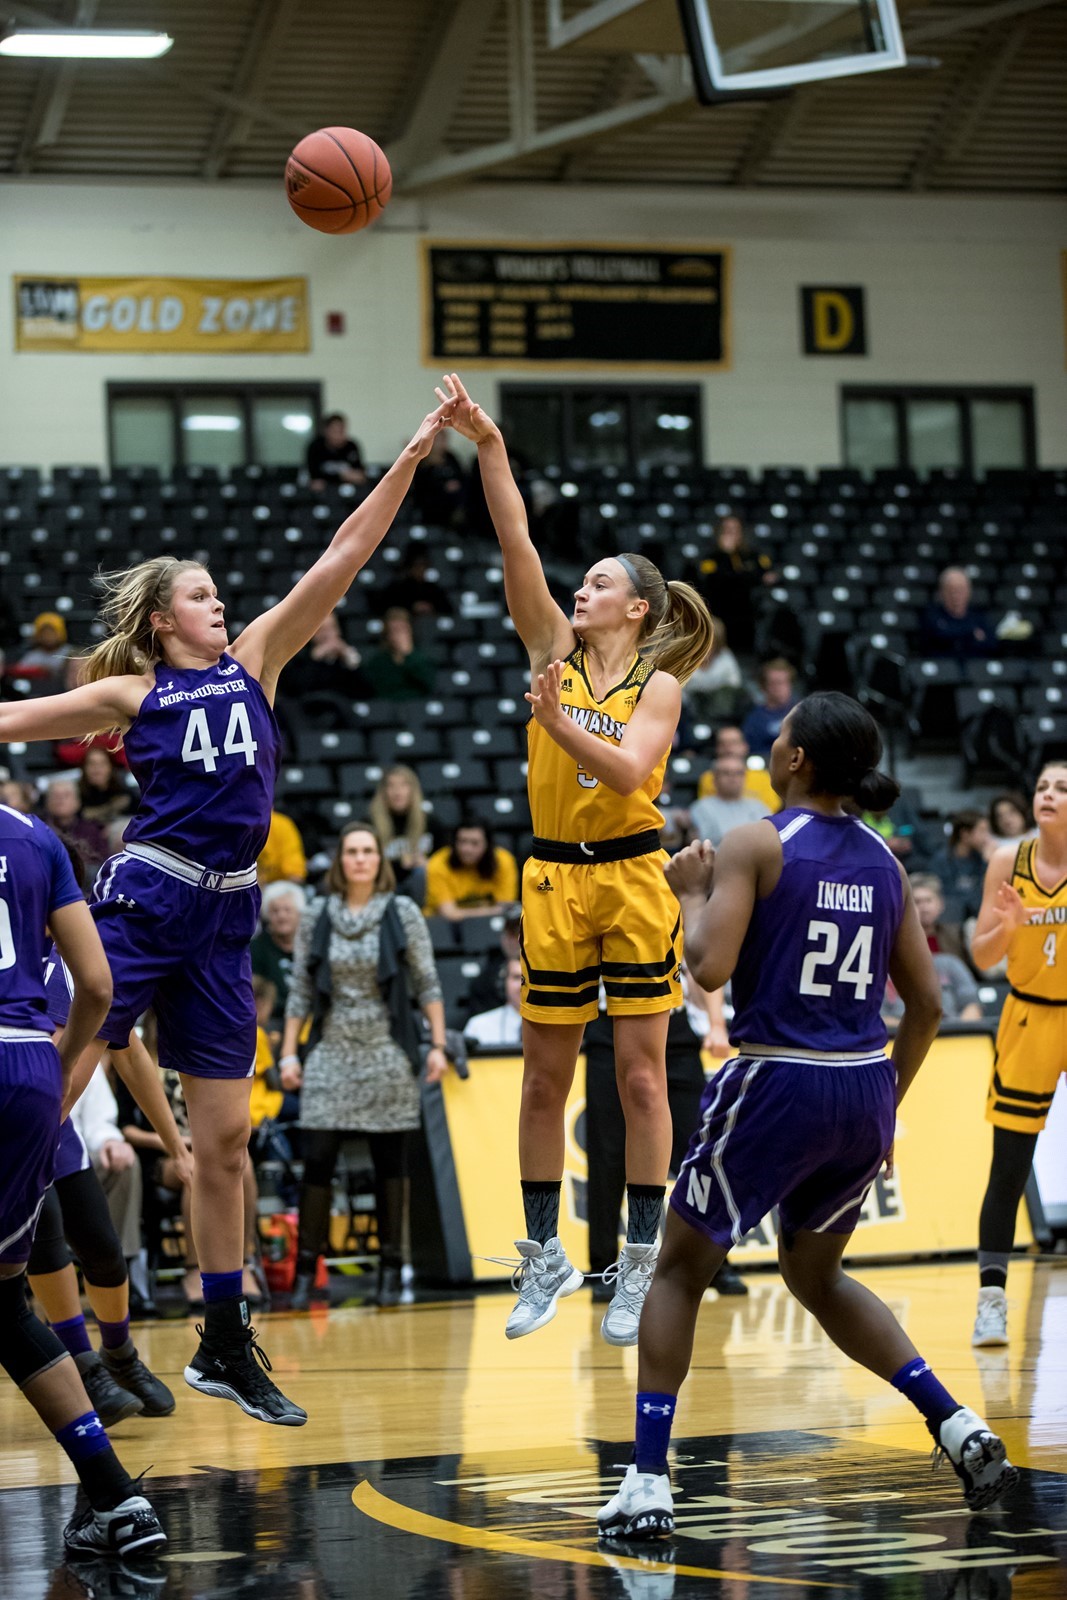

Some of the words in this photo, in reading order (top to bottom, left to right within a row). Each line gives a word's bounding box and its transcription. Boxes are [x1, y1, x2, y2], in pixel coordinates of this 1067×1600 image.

[81, 295, 184, 333] GOLD
[199, 296, 297, 333] ZONE
[814, 291, 854, 349] D
[158, 679, 249, 708] NORTHWESTER
[181, 702, 258, 773] 44
[816, 880, 874, 913] INMAN
[799, 920, 874, 1000] 24
[1043, 932, 1057, 967] 4
[686, 1166, 712, 1214] N
